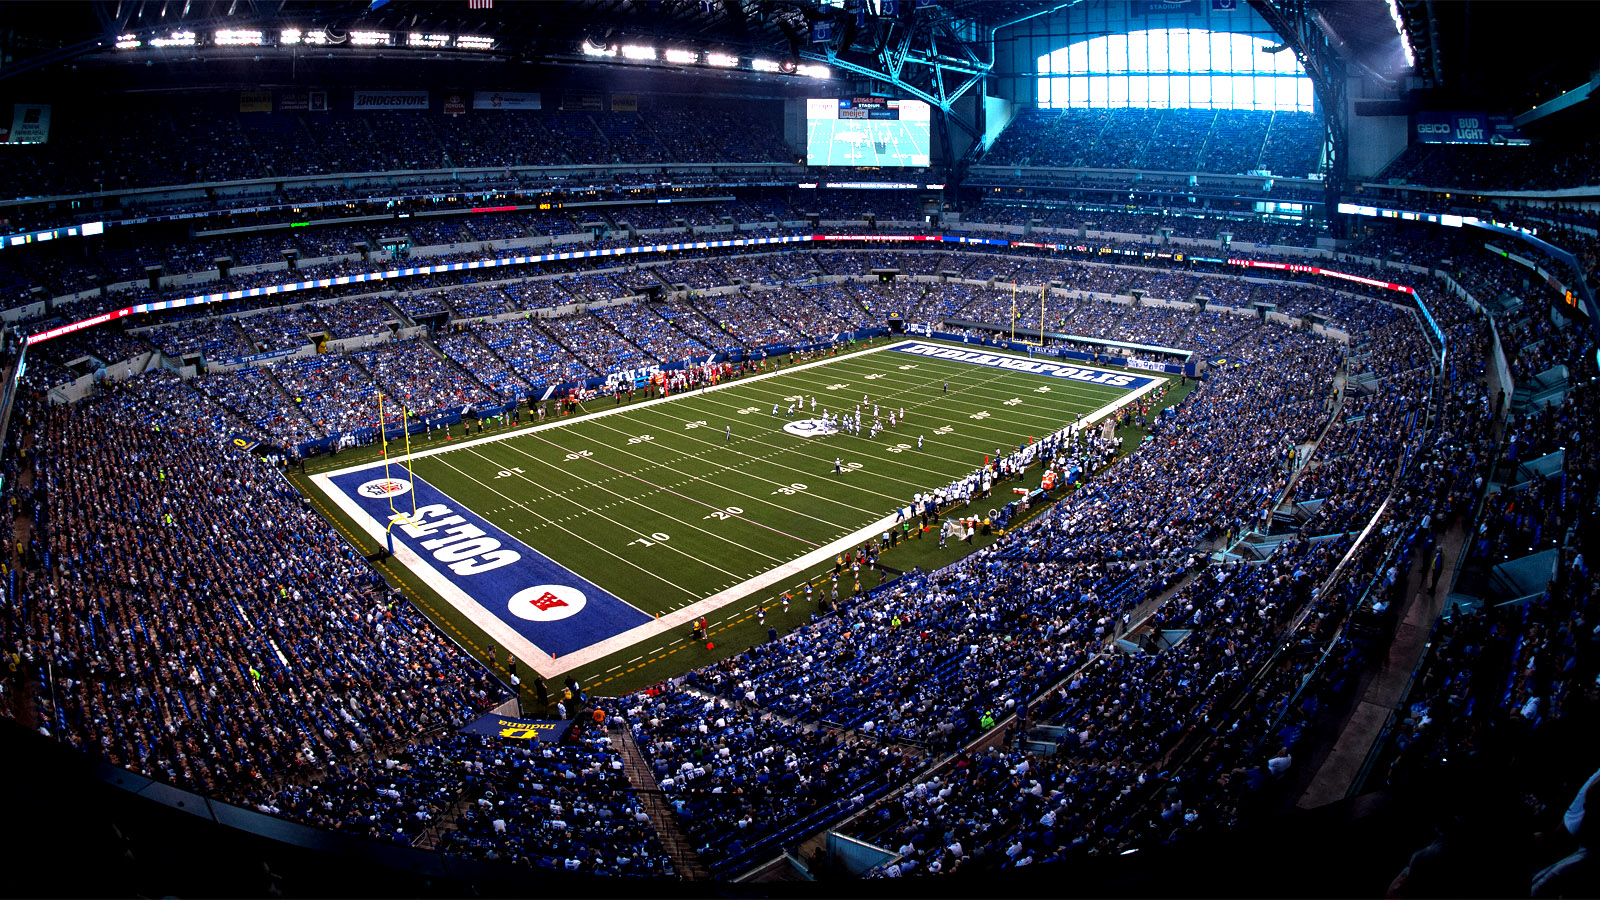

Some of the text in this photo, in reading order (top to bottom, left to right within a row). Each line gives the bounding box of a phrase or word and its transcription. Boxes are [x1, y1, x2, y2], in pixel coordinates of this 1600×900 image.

[357, 94, 427, 106] BRIDGESTONE
[842, 109, 866, 118] meijer
[1417, 123, 1450, 134] GEICO
[1457, 118, 1479, 129] BUD
[1456, 129, 1484, 140] LIGHT
[902, 343, 1136, 386] INDIANAPOLIS
[608, 365, 660, 385] COLTS
[886, 443, 911, 454] 50
[569, 450, 594, 461] 20
[498, 467, 526, 478] 10
[778, 483, 808, 495] 30
[710, 506, 744, 521] 20
[387, 503, 521, 576] COLTS
[635, 532, 671, 547] 10
[498, 719, 556, 730] Indiana
